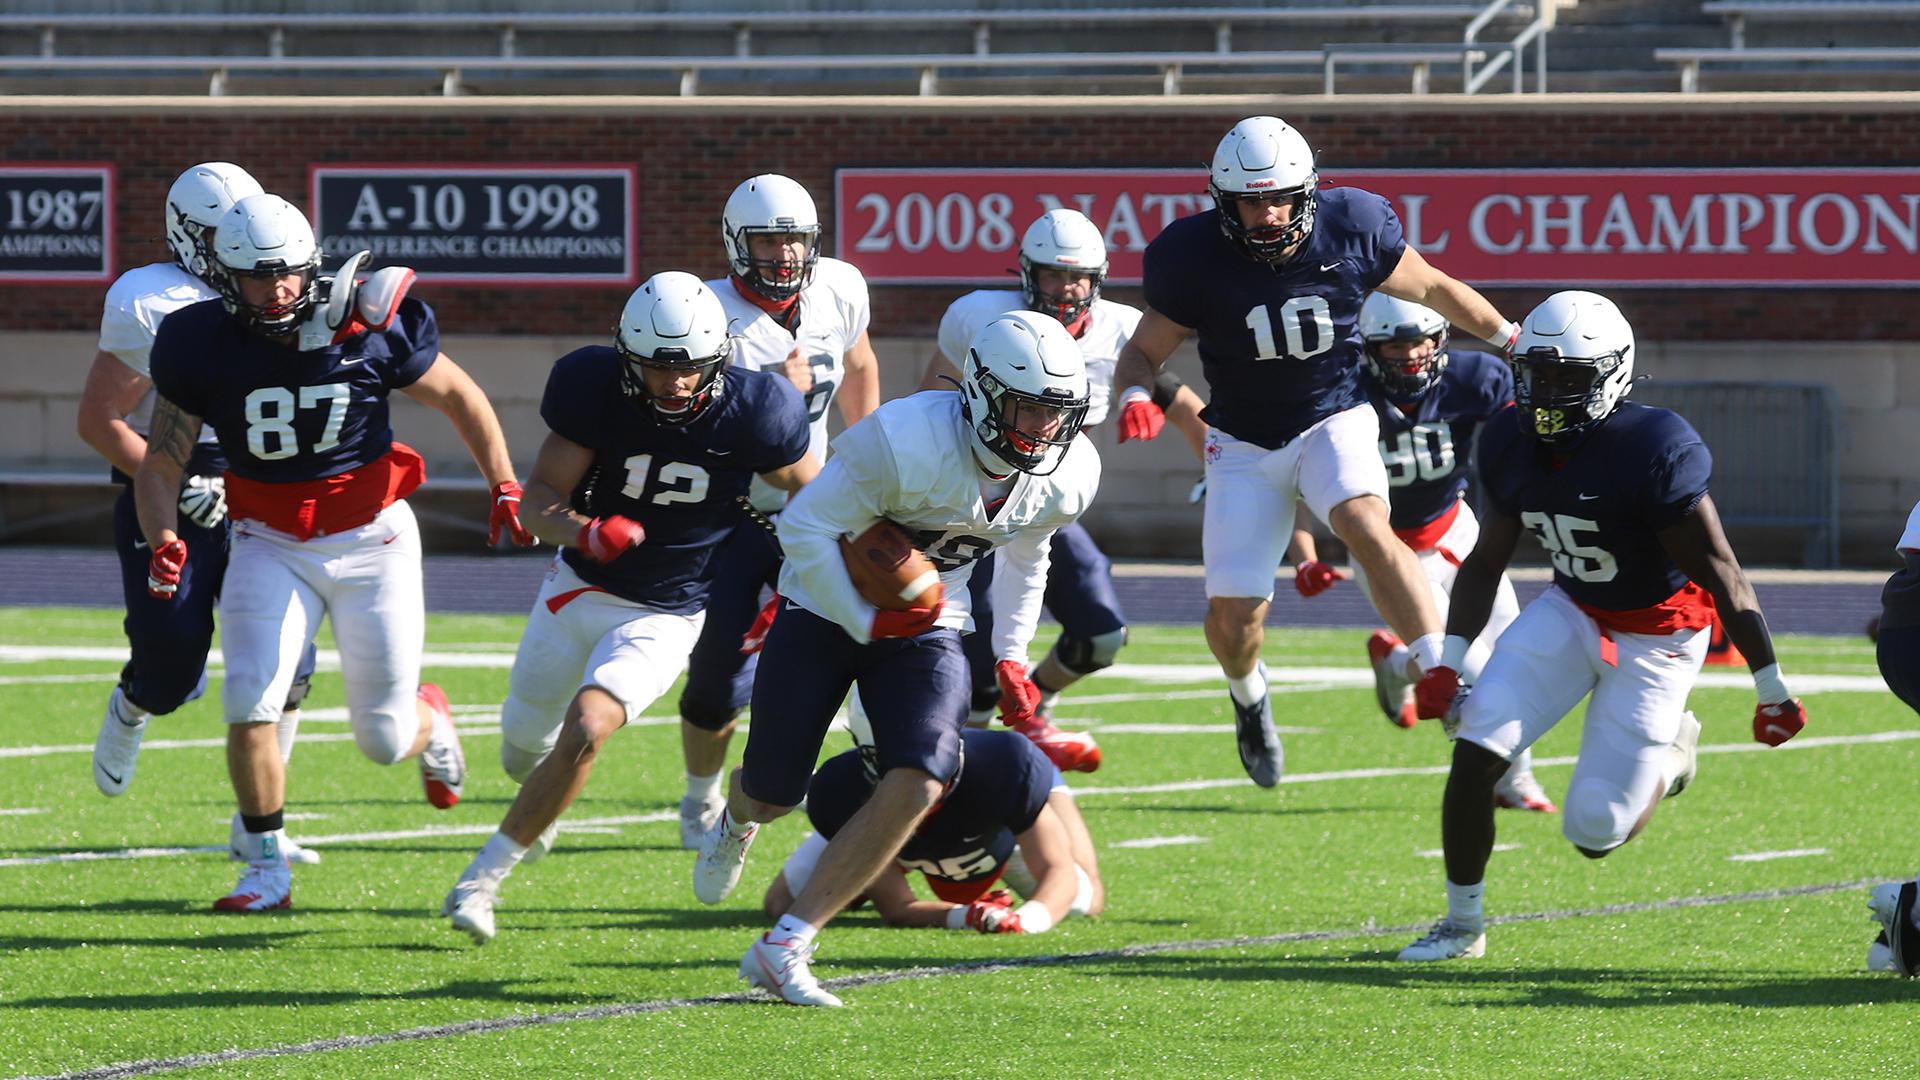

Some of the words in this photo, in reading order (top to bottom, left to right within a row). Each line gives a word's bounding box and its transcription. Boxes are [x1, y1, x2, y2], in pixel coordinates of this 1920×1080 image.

[6, 188, 102, 231] 1987
[346, 182, 466, 232] A-10
[482, 183, 600, 232] 1998
[1246, 180, 1274, 189] Riddell
[322, 235, 480, 259] CONFERENCE
[481, 235, 624, 259] CHAMPIONS
[853, 192, 1015, 254] 2008
[1468, 191, 1920, 255] CHAMPION
[1245, 294, 1335, 361] 10
[245, 382, 350, 460] 87
[621, 453, 710, 506] 12
